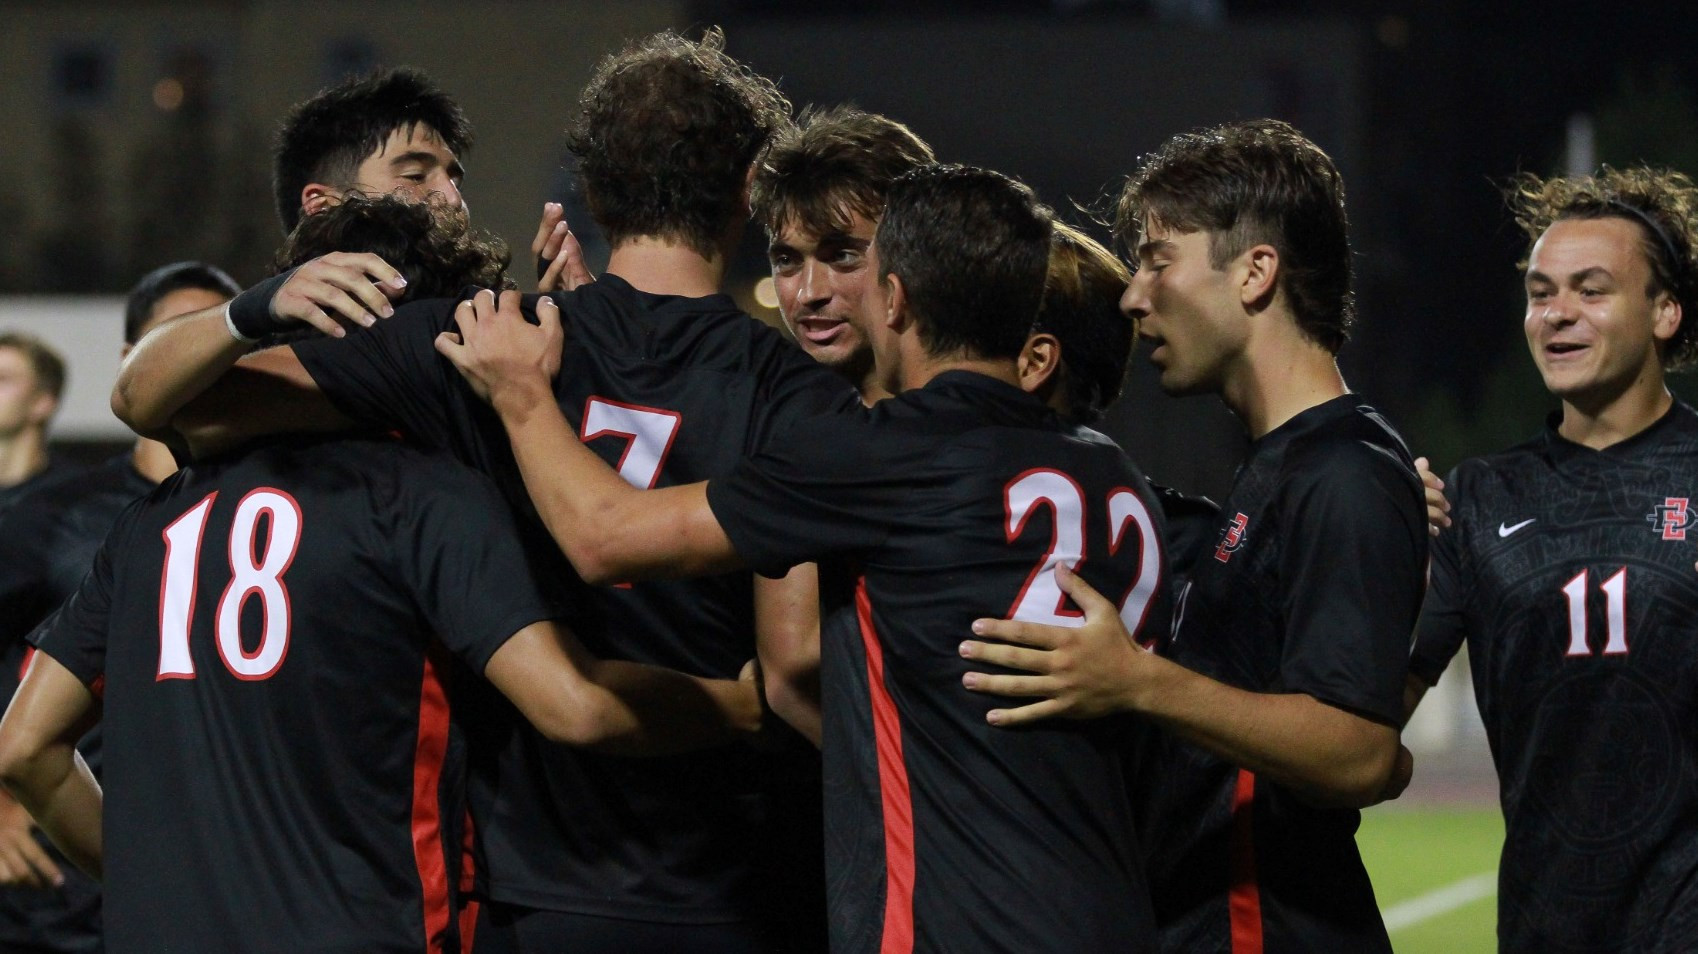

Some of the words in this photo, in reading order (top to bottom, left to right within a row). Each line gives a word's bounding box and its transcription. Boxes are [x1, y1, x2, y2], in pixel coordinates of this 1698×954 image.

[580, 394, 683, 491] 7
[156, 486, 303, 682] 18
[1003, 467, 1162, 648] 22
[1561, 565, 1630, 657] 11
